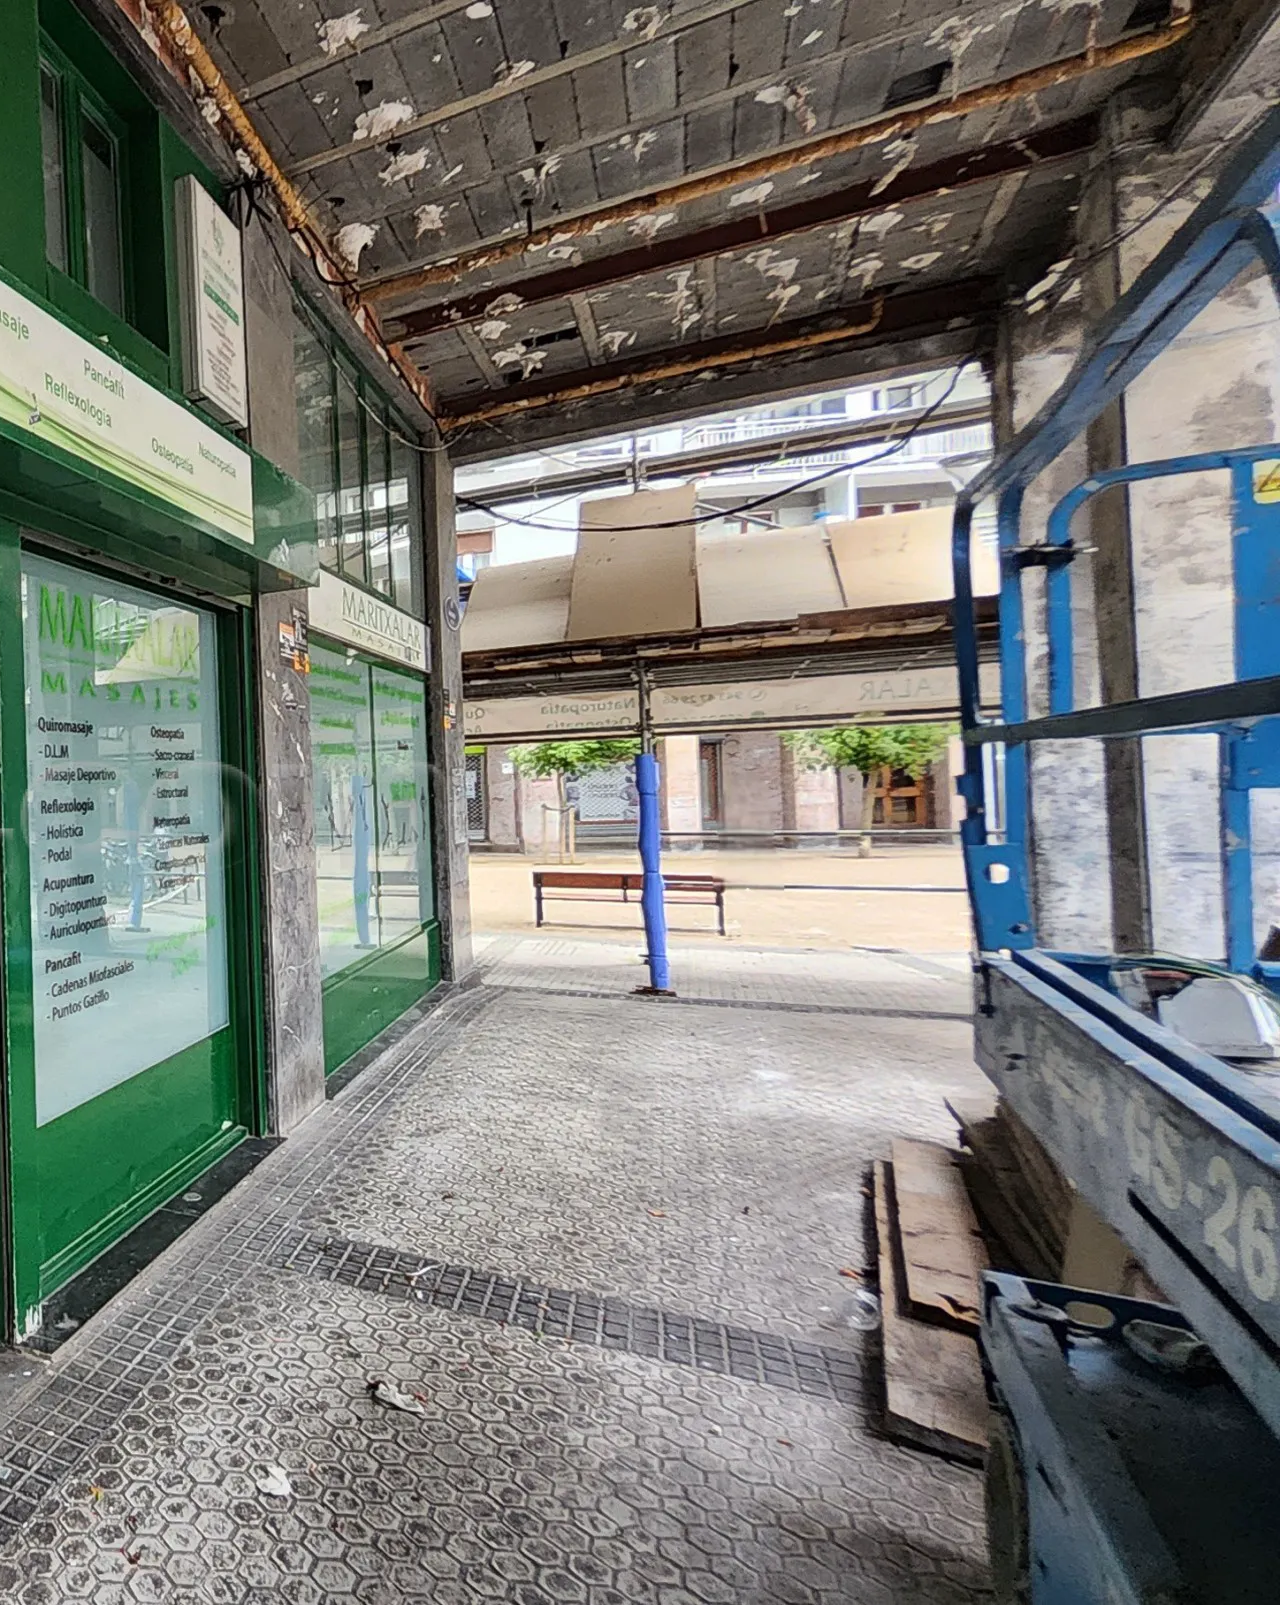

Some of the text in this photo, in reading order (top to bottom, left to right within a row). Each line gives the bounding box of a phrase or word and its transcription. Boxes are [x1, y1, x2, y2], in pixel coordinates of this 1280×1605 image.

[83, 358, 125, 400] Pancafit
[342, 587, 421, 650] MARITXALAR
[41, 670, 199, 711] MASAJES
[37, 717, 93, 737] Quiromasaje
[45, 768, 117, 785] Masaje Deportivo
[40, 797, 94, 817] Reflexología
[47, 848, 72, 864] Podal
[43, 872, 95, 894] Acupuntura
[49, 894, 108, 918] Digitopuntura
[45, 951, 82, 973] Pancafit
[51, 959, 135, 998] Cadenas Miofasciales
[52, 989, 110, 1022] Puntos Gatillo
